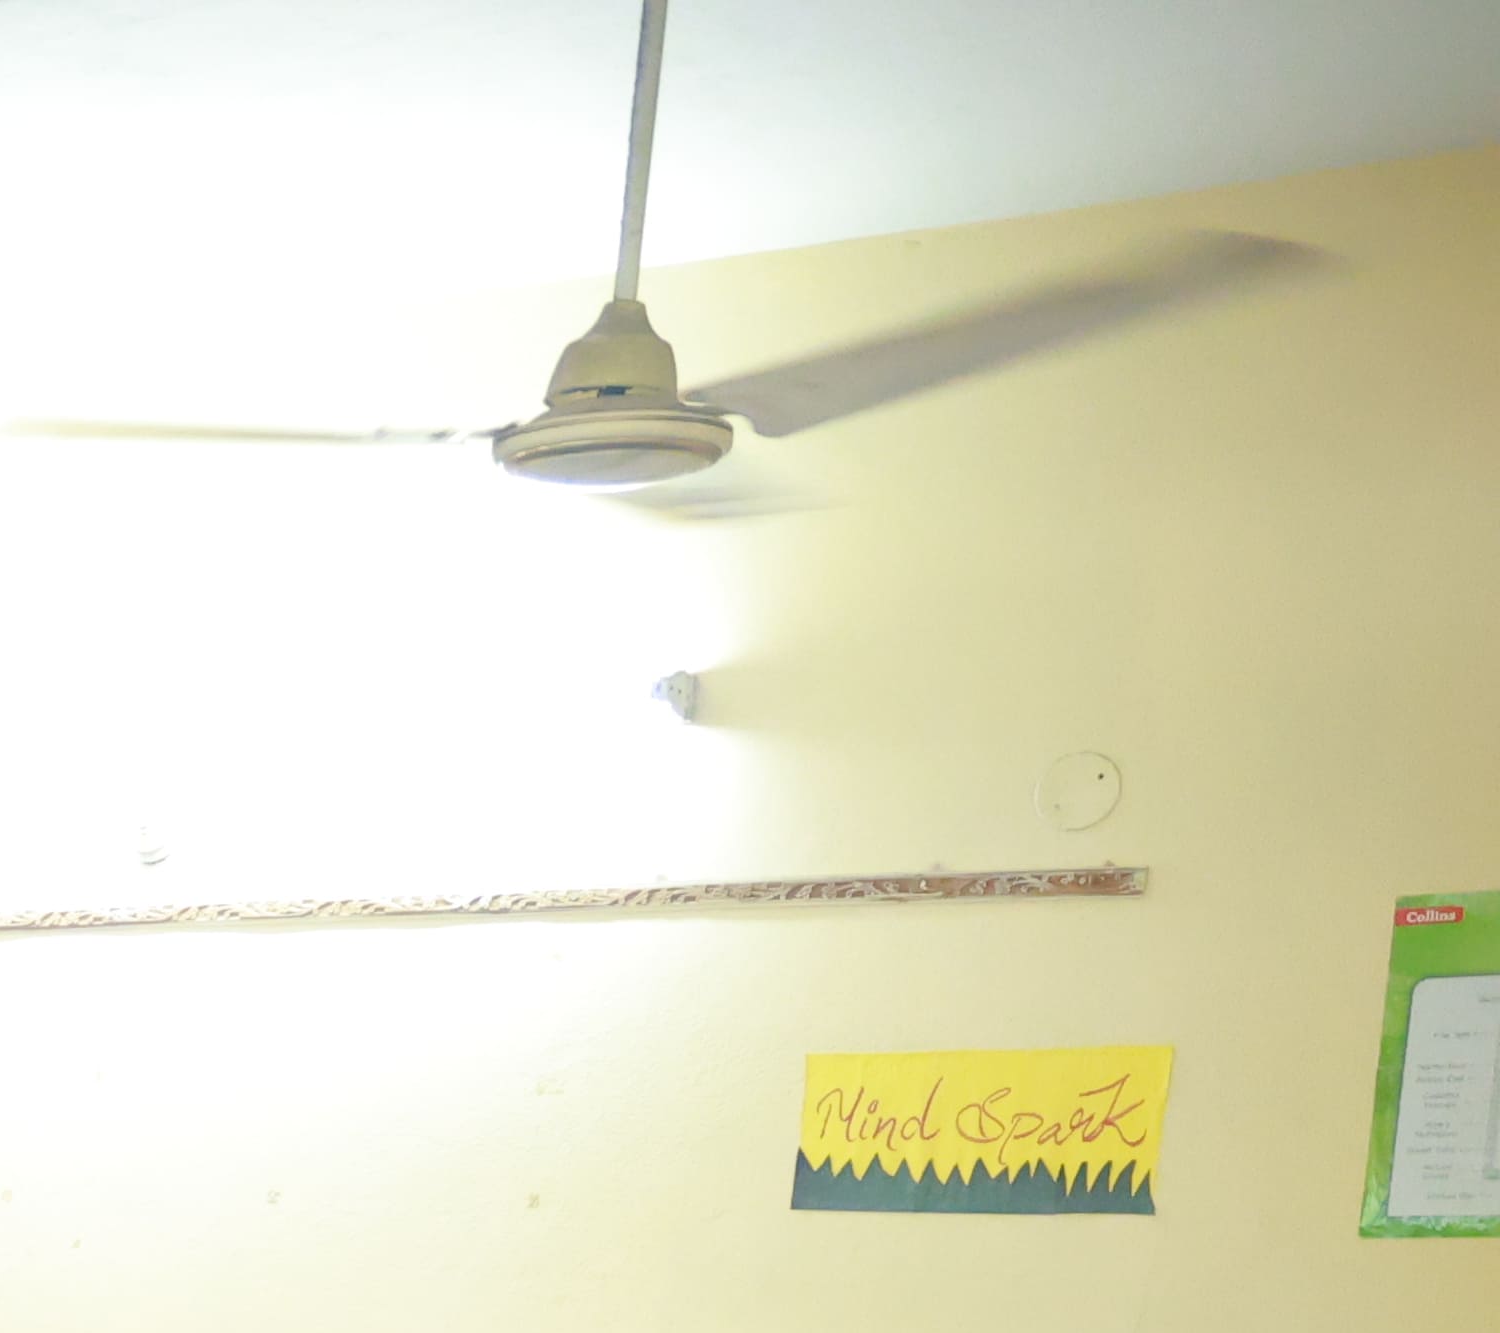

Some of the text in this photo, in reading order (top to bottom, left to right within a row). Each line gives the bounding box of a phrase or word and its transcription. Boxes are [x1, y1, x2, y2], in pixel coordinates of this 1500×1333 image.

[1405, 910, 1457, 924] Collins
[816, 1073, 1148, 1170] Mind Spark
